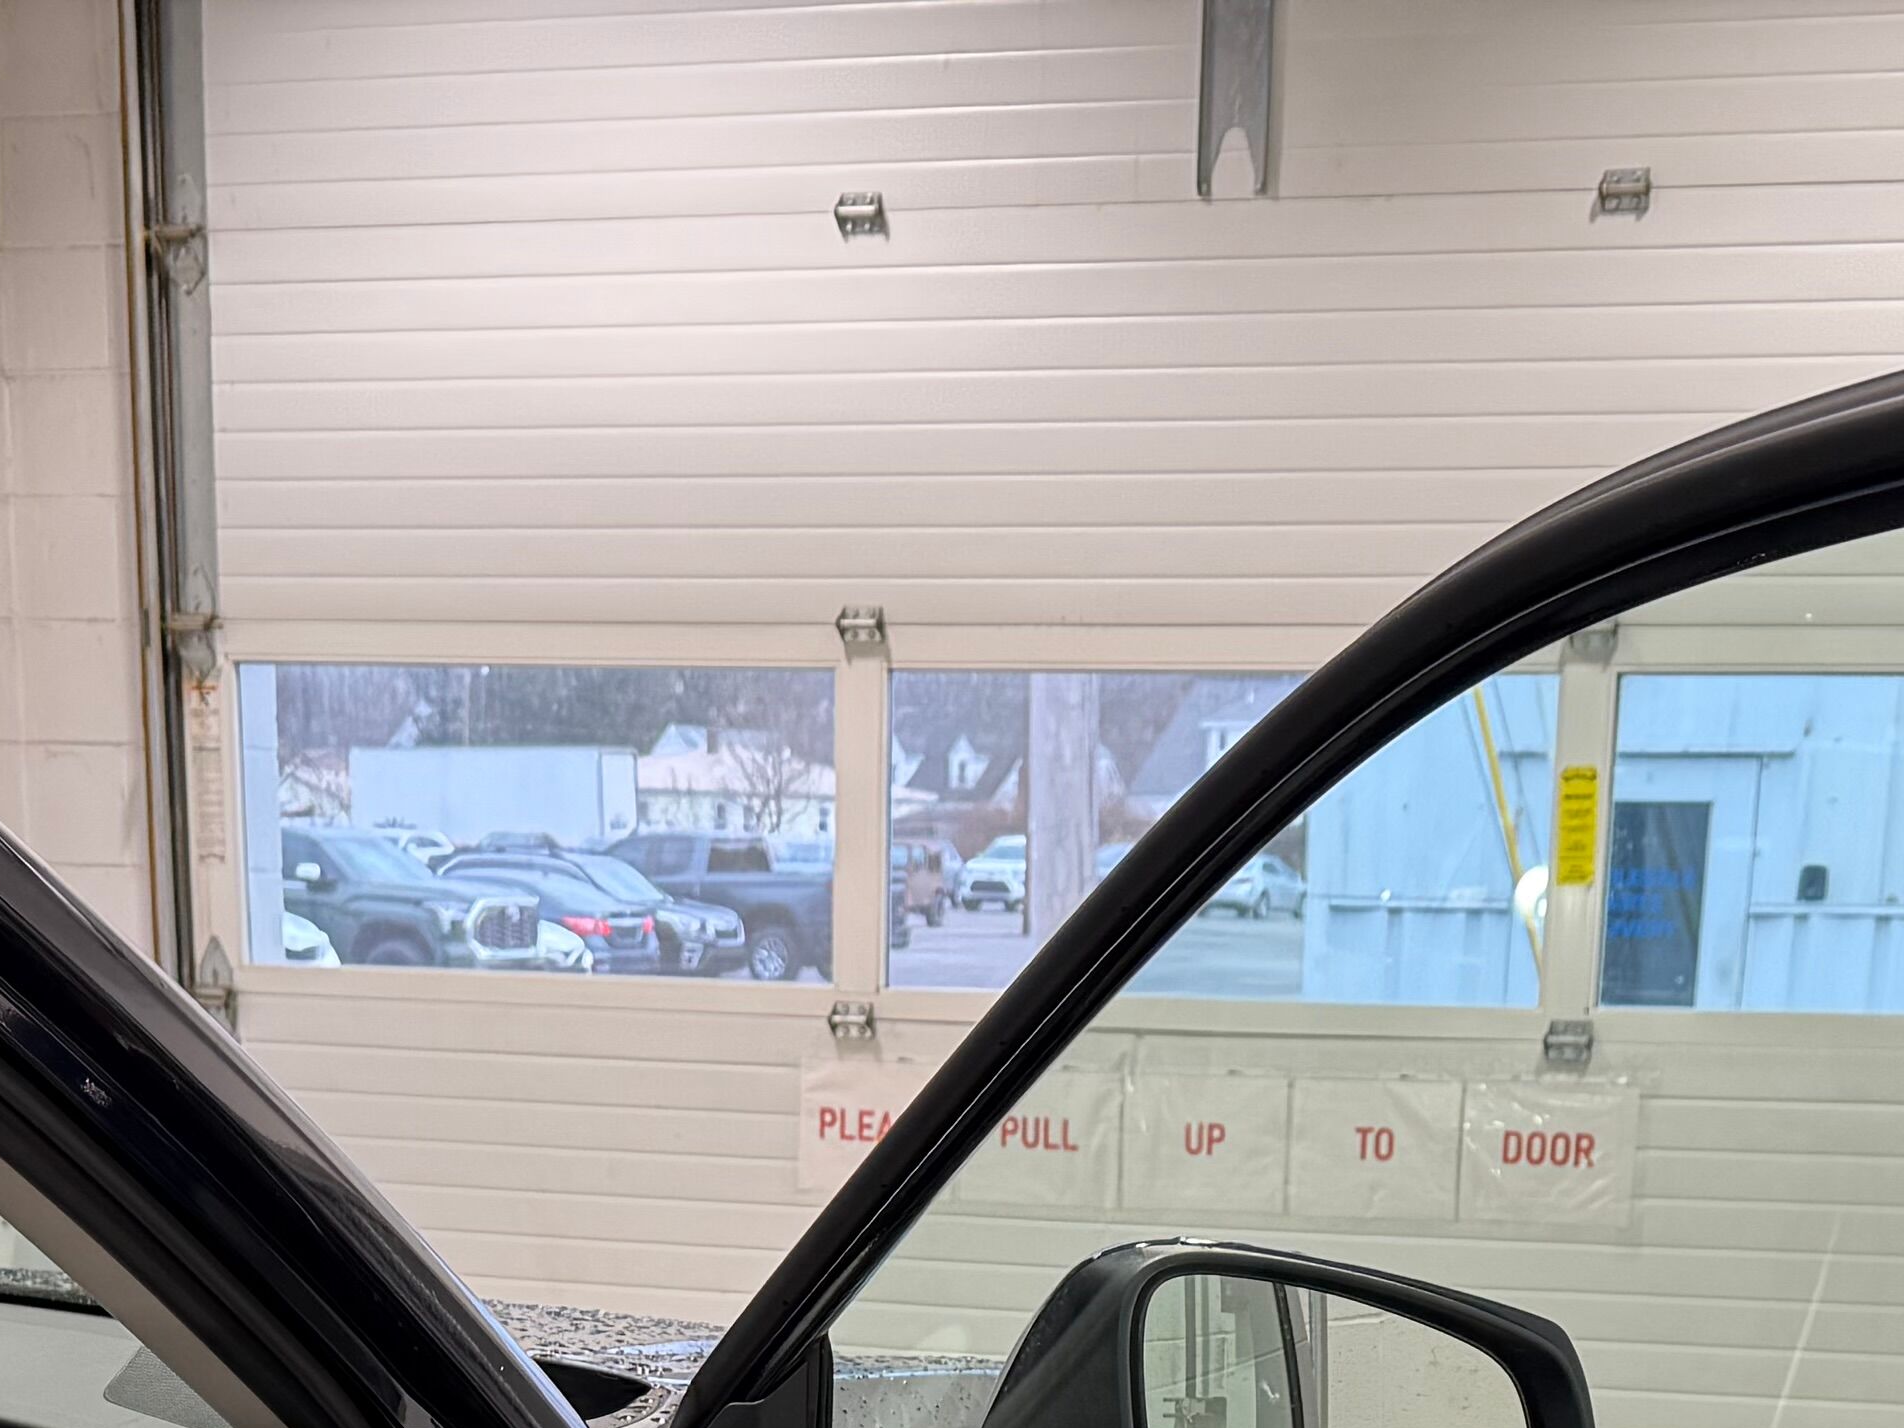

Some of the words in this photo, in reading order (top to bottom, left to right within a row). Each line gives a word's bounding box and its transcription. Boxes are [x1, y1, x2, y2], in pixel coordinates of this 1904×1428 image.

[818, 1105, 893, 1145] PLEA
[1000, 1117, 1079, 1153] PULL
[1185, 1123, 1224, 1155] UP
[1359, 1128, 1394, 1161] TO
[1502, 1131, 1595, 1168] DOOR
